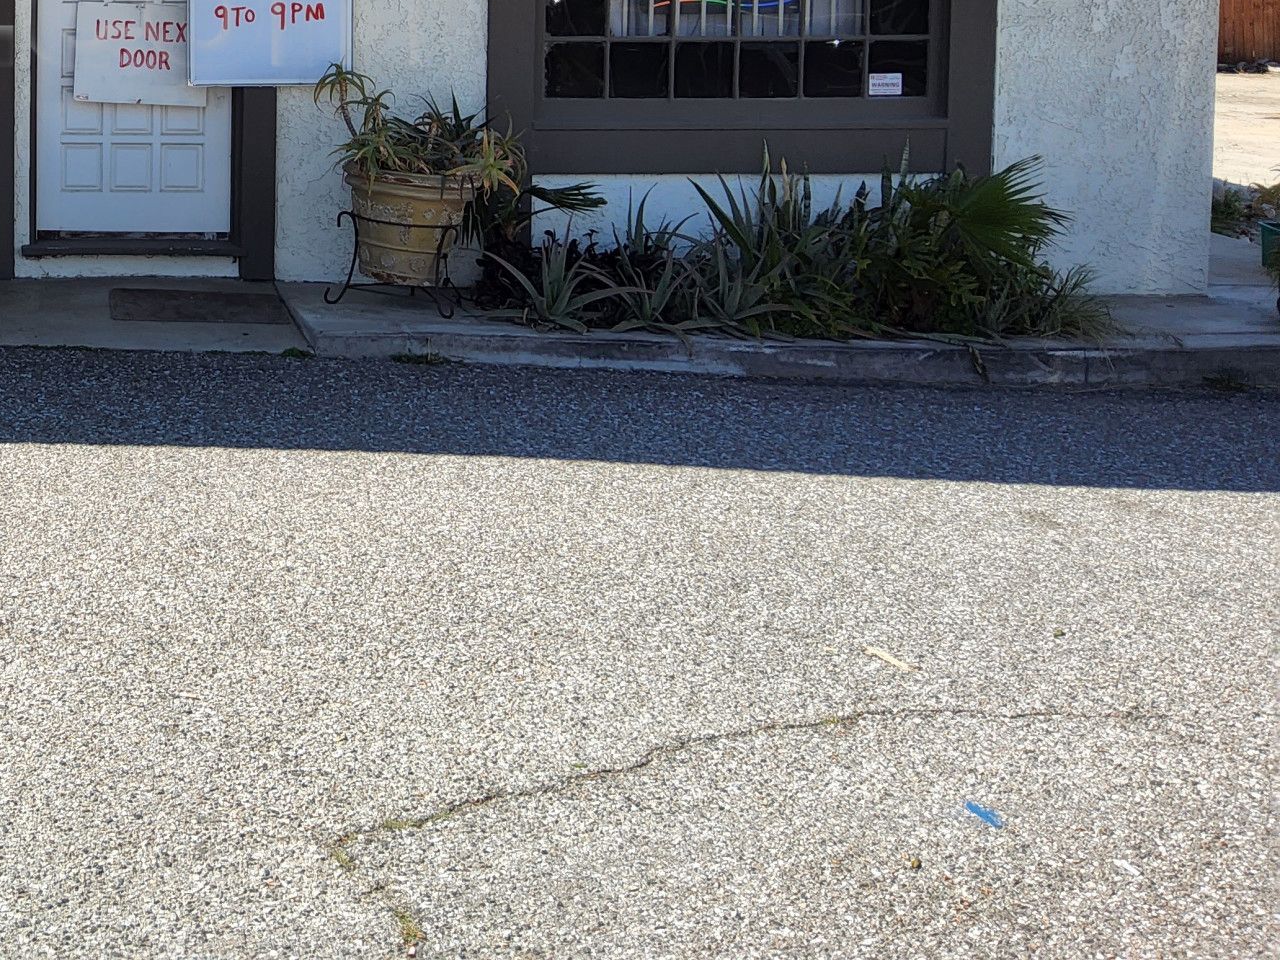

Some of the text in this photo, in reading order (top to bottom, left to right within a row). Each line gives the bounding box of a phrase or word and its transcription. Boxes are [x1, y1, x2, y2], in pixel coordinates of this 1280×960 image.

[214, 2, 325, 30] 9 TO 9 PM
[95, 19, 187, 43] USE NEX
[119, 48, 171, 70] DOOR
